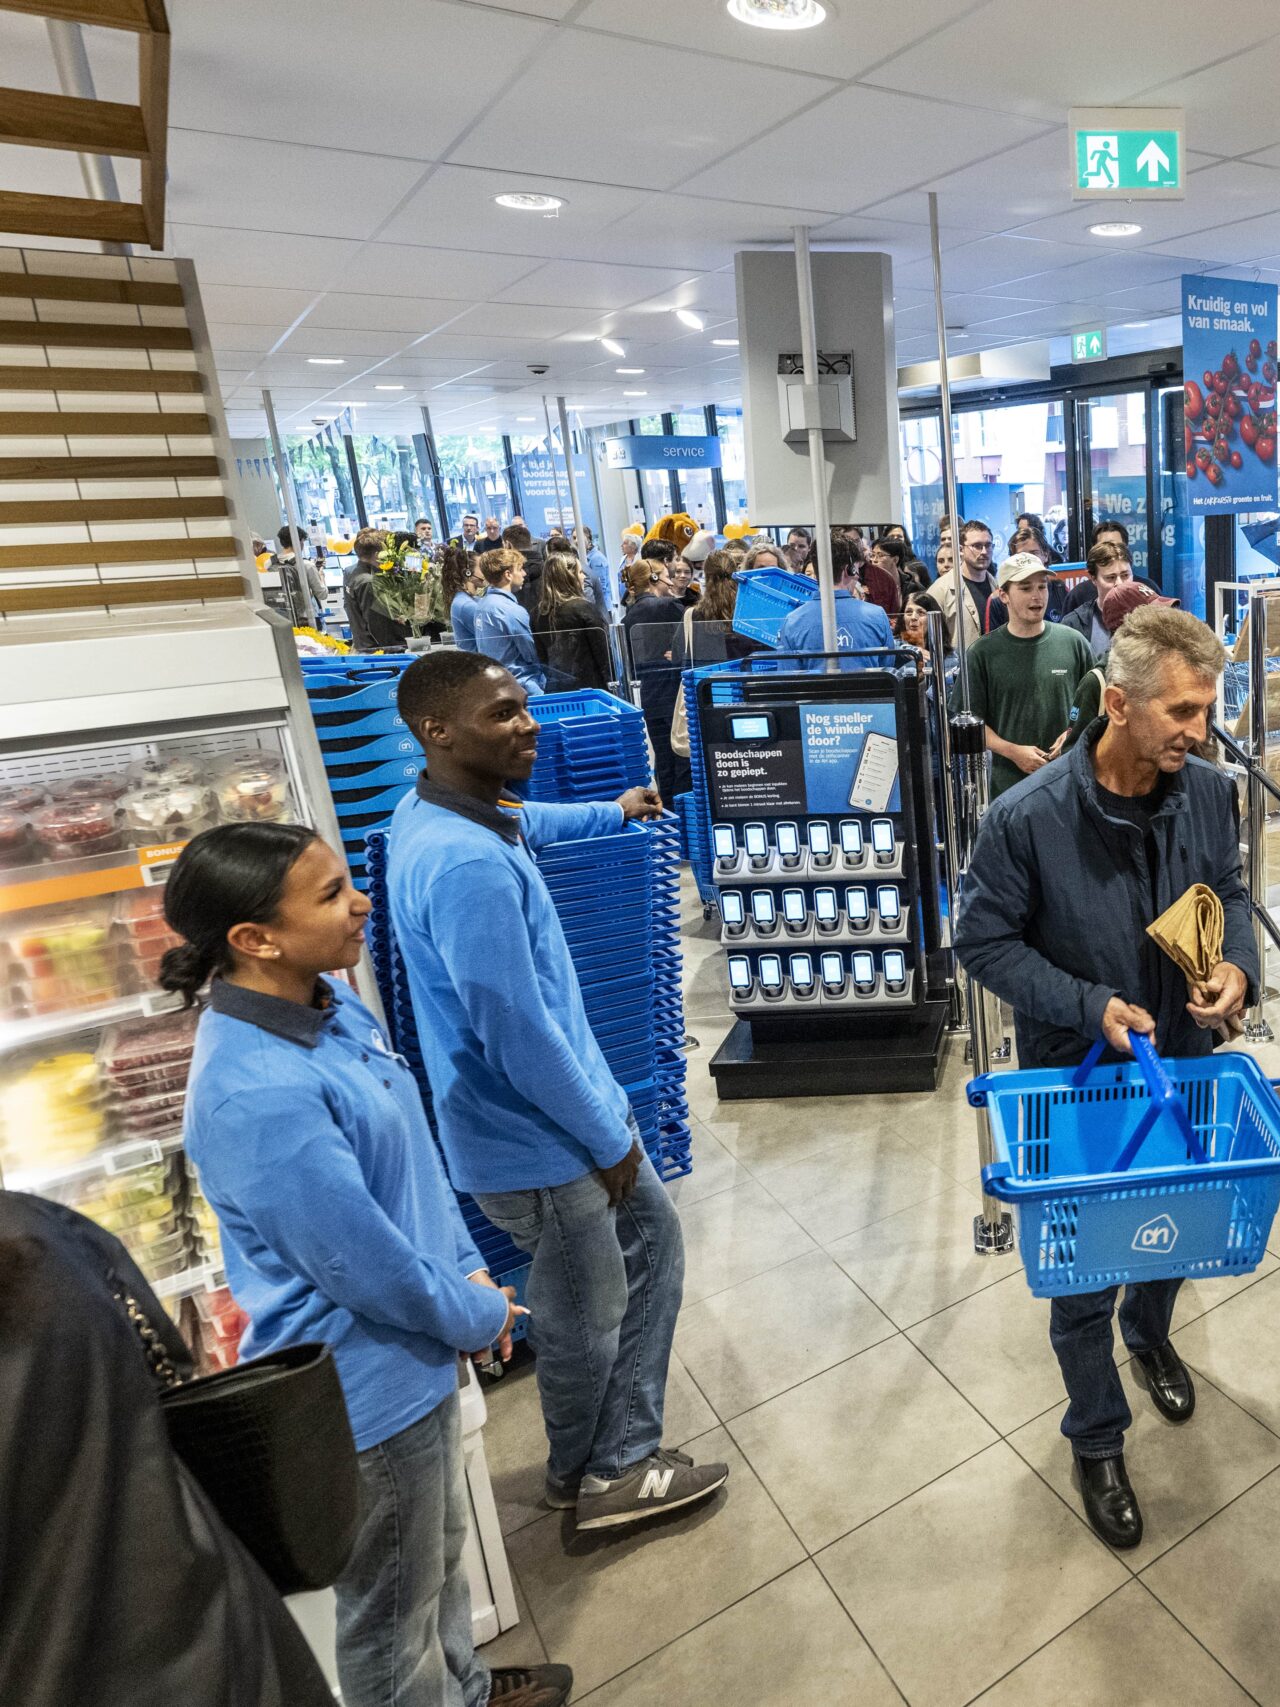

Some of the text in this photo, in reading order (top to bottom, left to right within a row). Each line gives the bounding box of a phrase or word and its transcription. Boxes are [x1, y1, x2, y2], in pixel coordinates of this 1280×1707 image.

[1188, 294, 1268, 316] Kruidig en vol
[1188, 316, 1255, 333] van smaak.
[663, 446, 705, 457] service
[1105, 494, 1132, 514] We
[806, 712, 873, 726] Nog sneller
[807, 723, 864, 735] de winkel
[807, 735, 841, 746] door?
[714, 749, 783, 760] Boodschappen
[716, 758, 750, 768] doen is
[717, 767, 768, 779] zo gepiept.
[146, 846, 185, 858] BONUS
[637, 1469, 675, 1499] N
